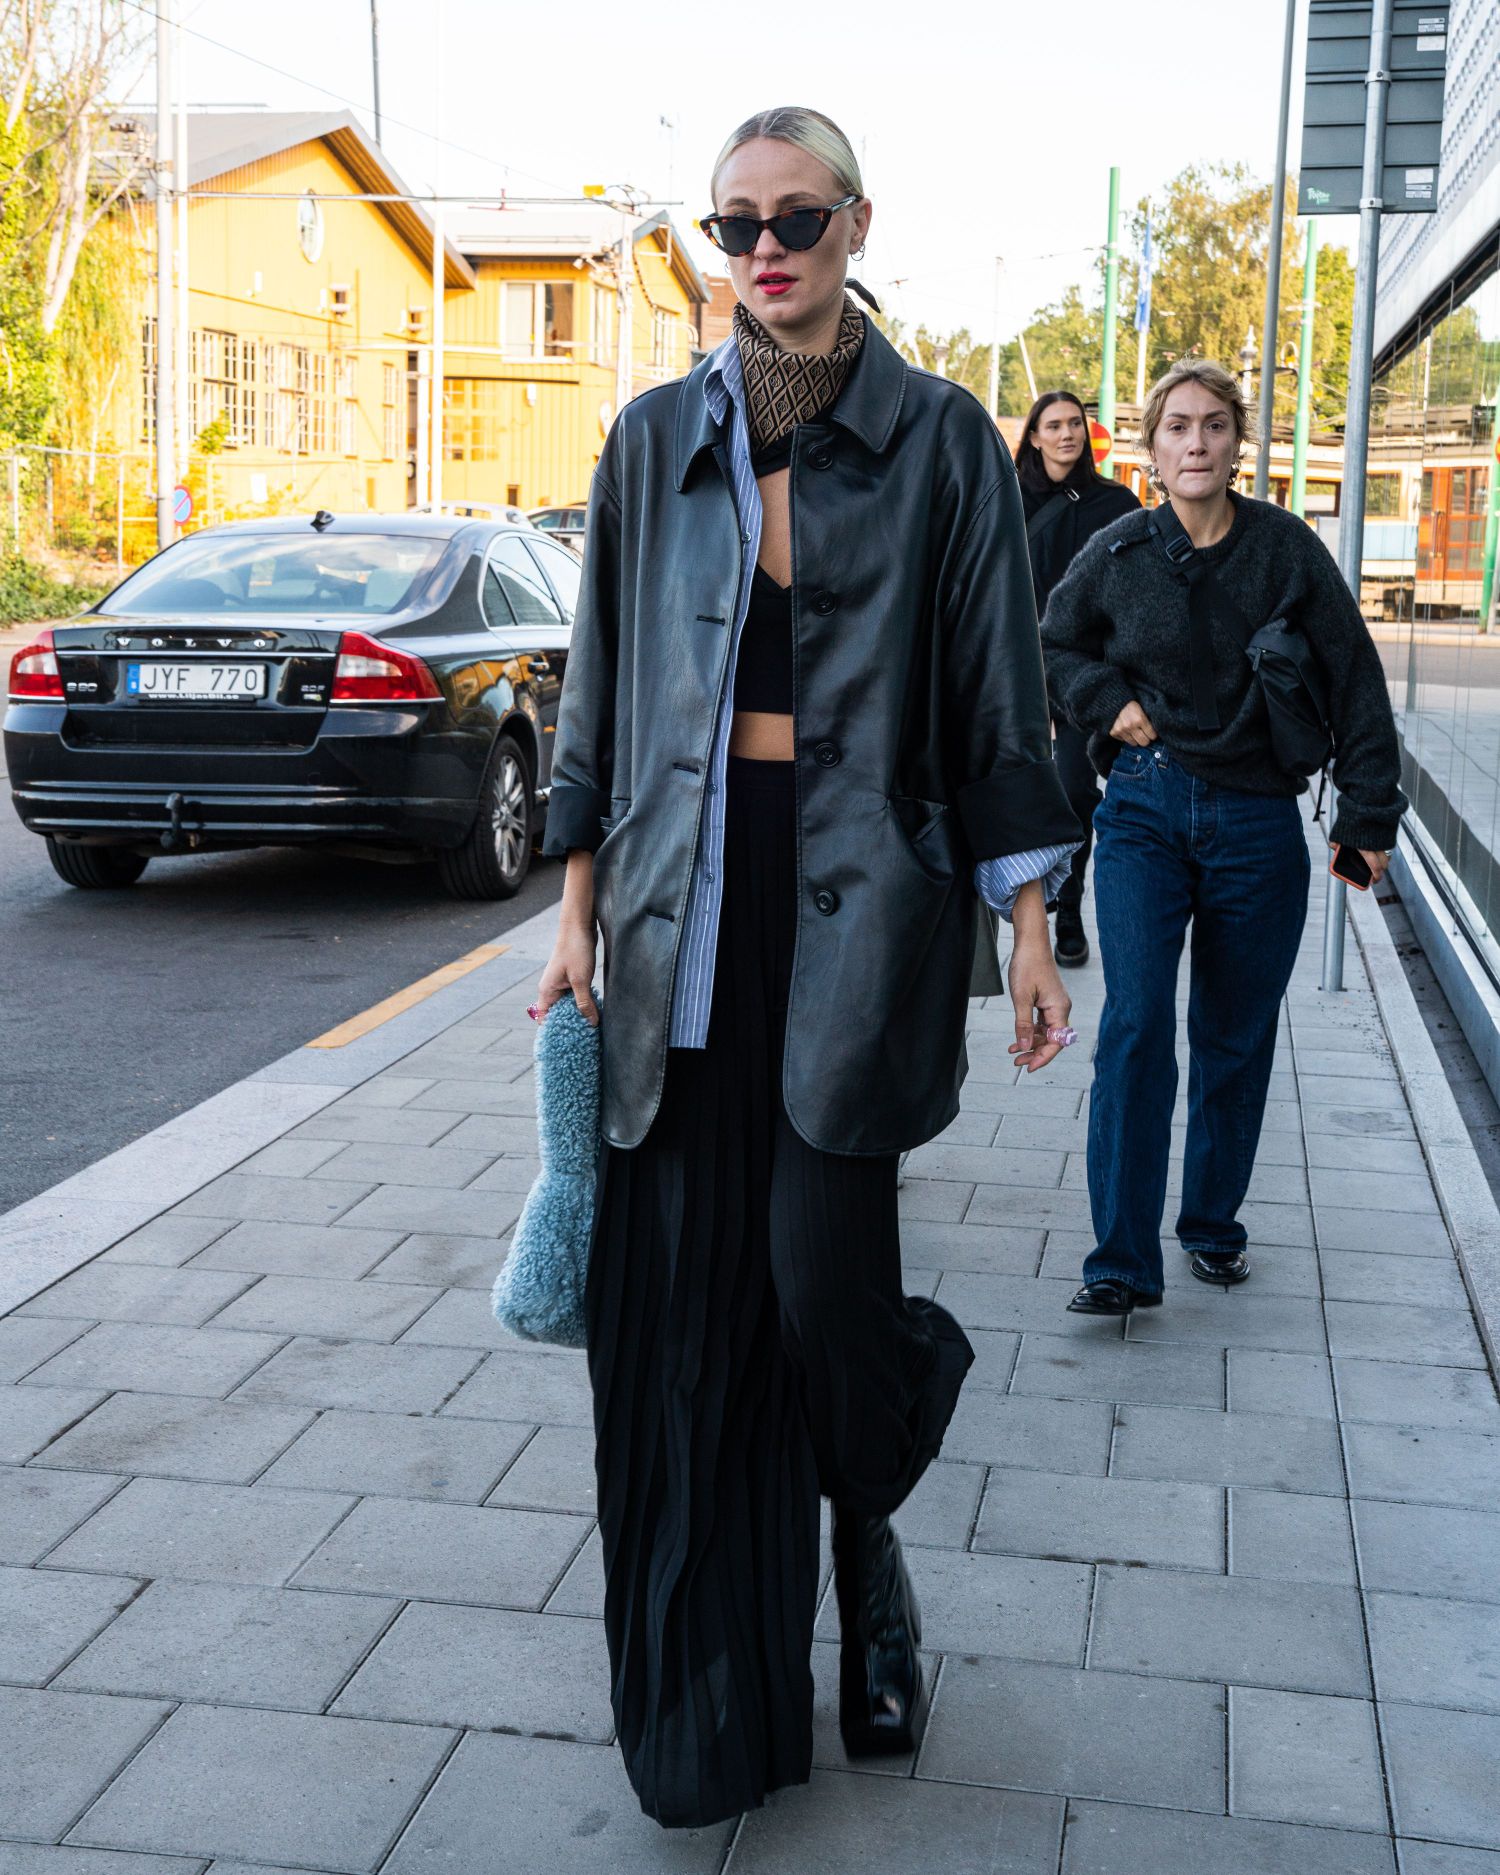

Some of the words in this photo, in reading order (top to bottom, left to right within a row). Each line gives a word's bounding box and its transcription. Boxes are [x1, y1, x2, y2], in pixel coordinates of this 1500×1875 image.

[116, 637, 265, 648] VOLVO
[144, 668, 190, 690] JYF
[211, 668, 257, 691] 770
